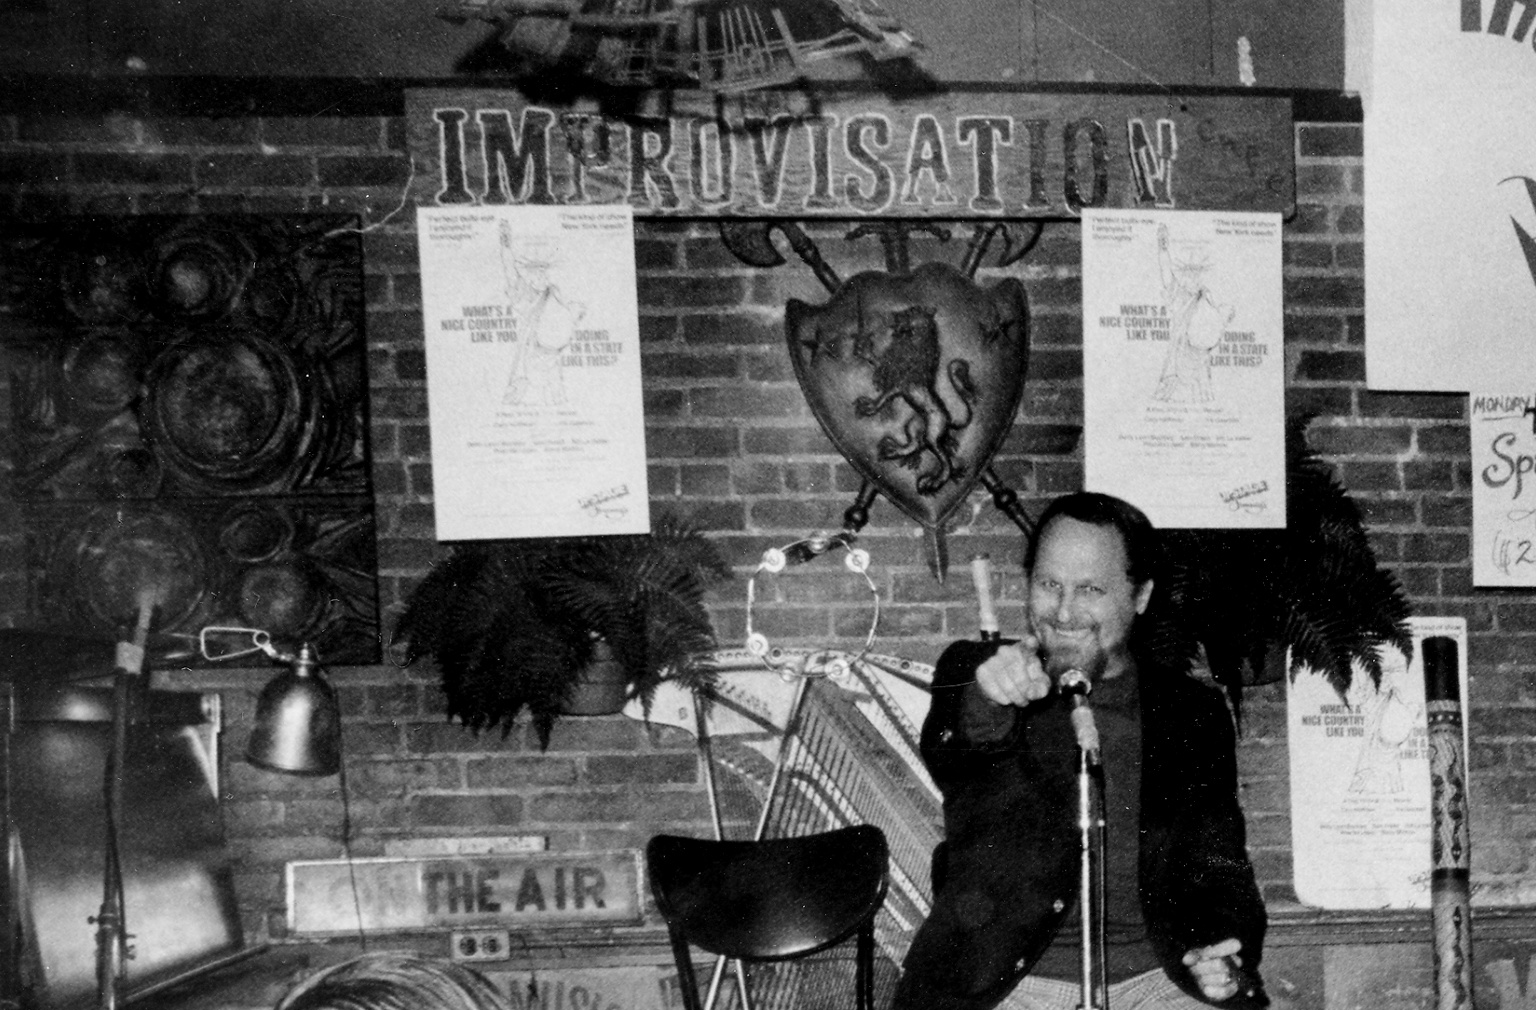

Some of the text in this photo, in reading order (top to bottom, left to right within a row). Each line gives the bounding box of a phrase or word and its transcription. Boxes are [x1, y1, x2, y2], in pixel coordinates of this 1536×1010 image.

[433, 107, 1178, 208] IMPROVISATION
[462, 305, 513, 318] WHAT'S A
[1119, 304, 1168, 317] WHAT'S A
[440, 318, 517, 331] NICE COUNTRY
[1099, 316, 1171, 329] NICE COUNTRY
[471, 331, 518, 344] LIKE YOU
[574, 329, 609, 341] DOING
[1126, 329, 1171, 341] LIKE YOU
[1223, 331, 1256, 343] DOING
[570, 341, 623, 354] IN A STATE
[1218, 343, 1268, 356] IN A STATE
[560, 355, 618, 367] LIKE THIS?
[1209, 355, 1263, 367] LIKE THIS?
[1355, 704, 1362, 714] A
[1302, 715, 1365, 726] NICE COUNTRY
[1326, 727, 1365, 738] LIKE YOU
[421, 867, 501, 915] THE
[514, 865, 607, 912] AIR
